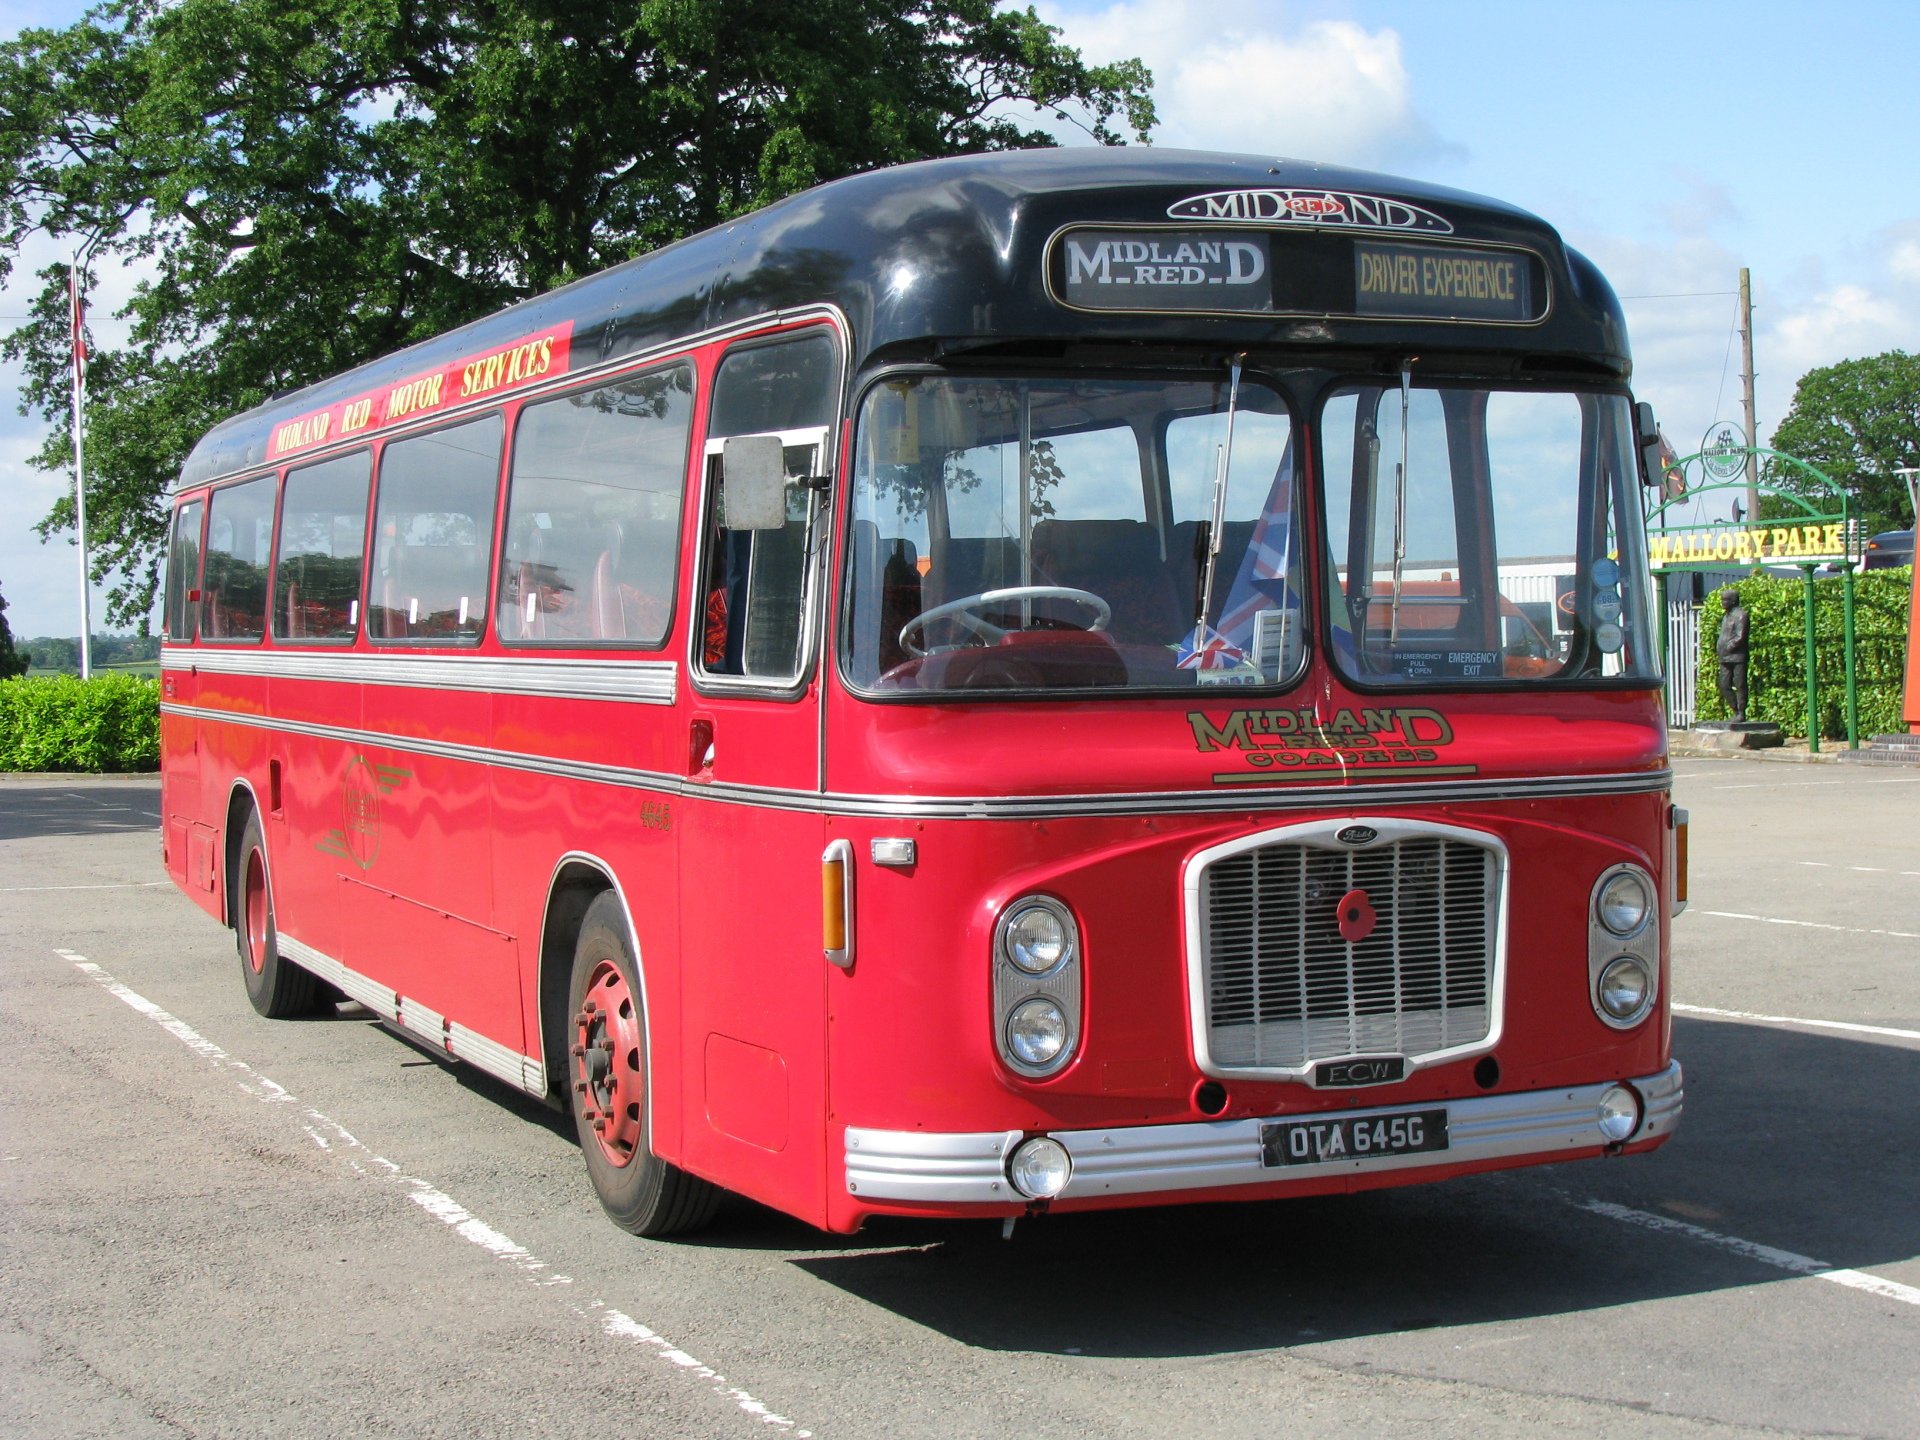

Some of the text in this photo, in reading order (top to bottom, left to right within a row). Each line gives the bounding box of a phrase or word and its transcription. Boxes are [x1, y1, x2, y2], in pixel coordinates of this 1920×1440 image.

[1292, 199, 1337, 214] RED
[1360, 251, 1515, 300] DRIVER EXPERIENCE
[275, 335, 555, 454] MIDLAND RED MOTOR SERVICES
[1649, 523, 1844, 563] MALLORY PARK
[1448, 652, 1498, 663] EMERGENCY
[1414, 667, 1432, 675] OPEN
[1463, 664, 1481, 676] EXIT
[1187, 708, 1454, 752] MIDLAND
[1246, 748, 1438, 767] COACHES
[1329, 1063, 1389, 1083] ECW
[1290, 1116, 1424, 1157] OTA 645G
